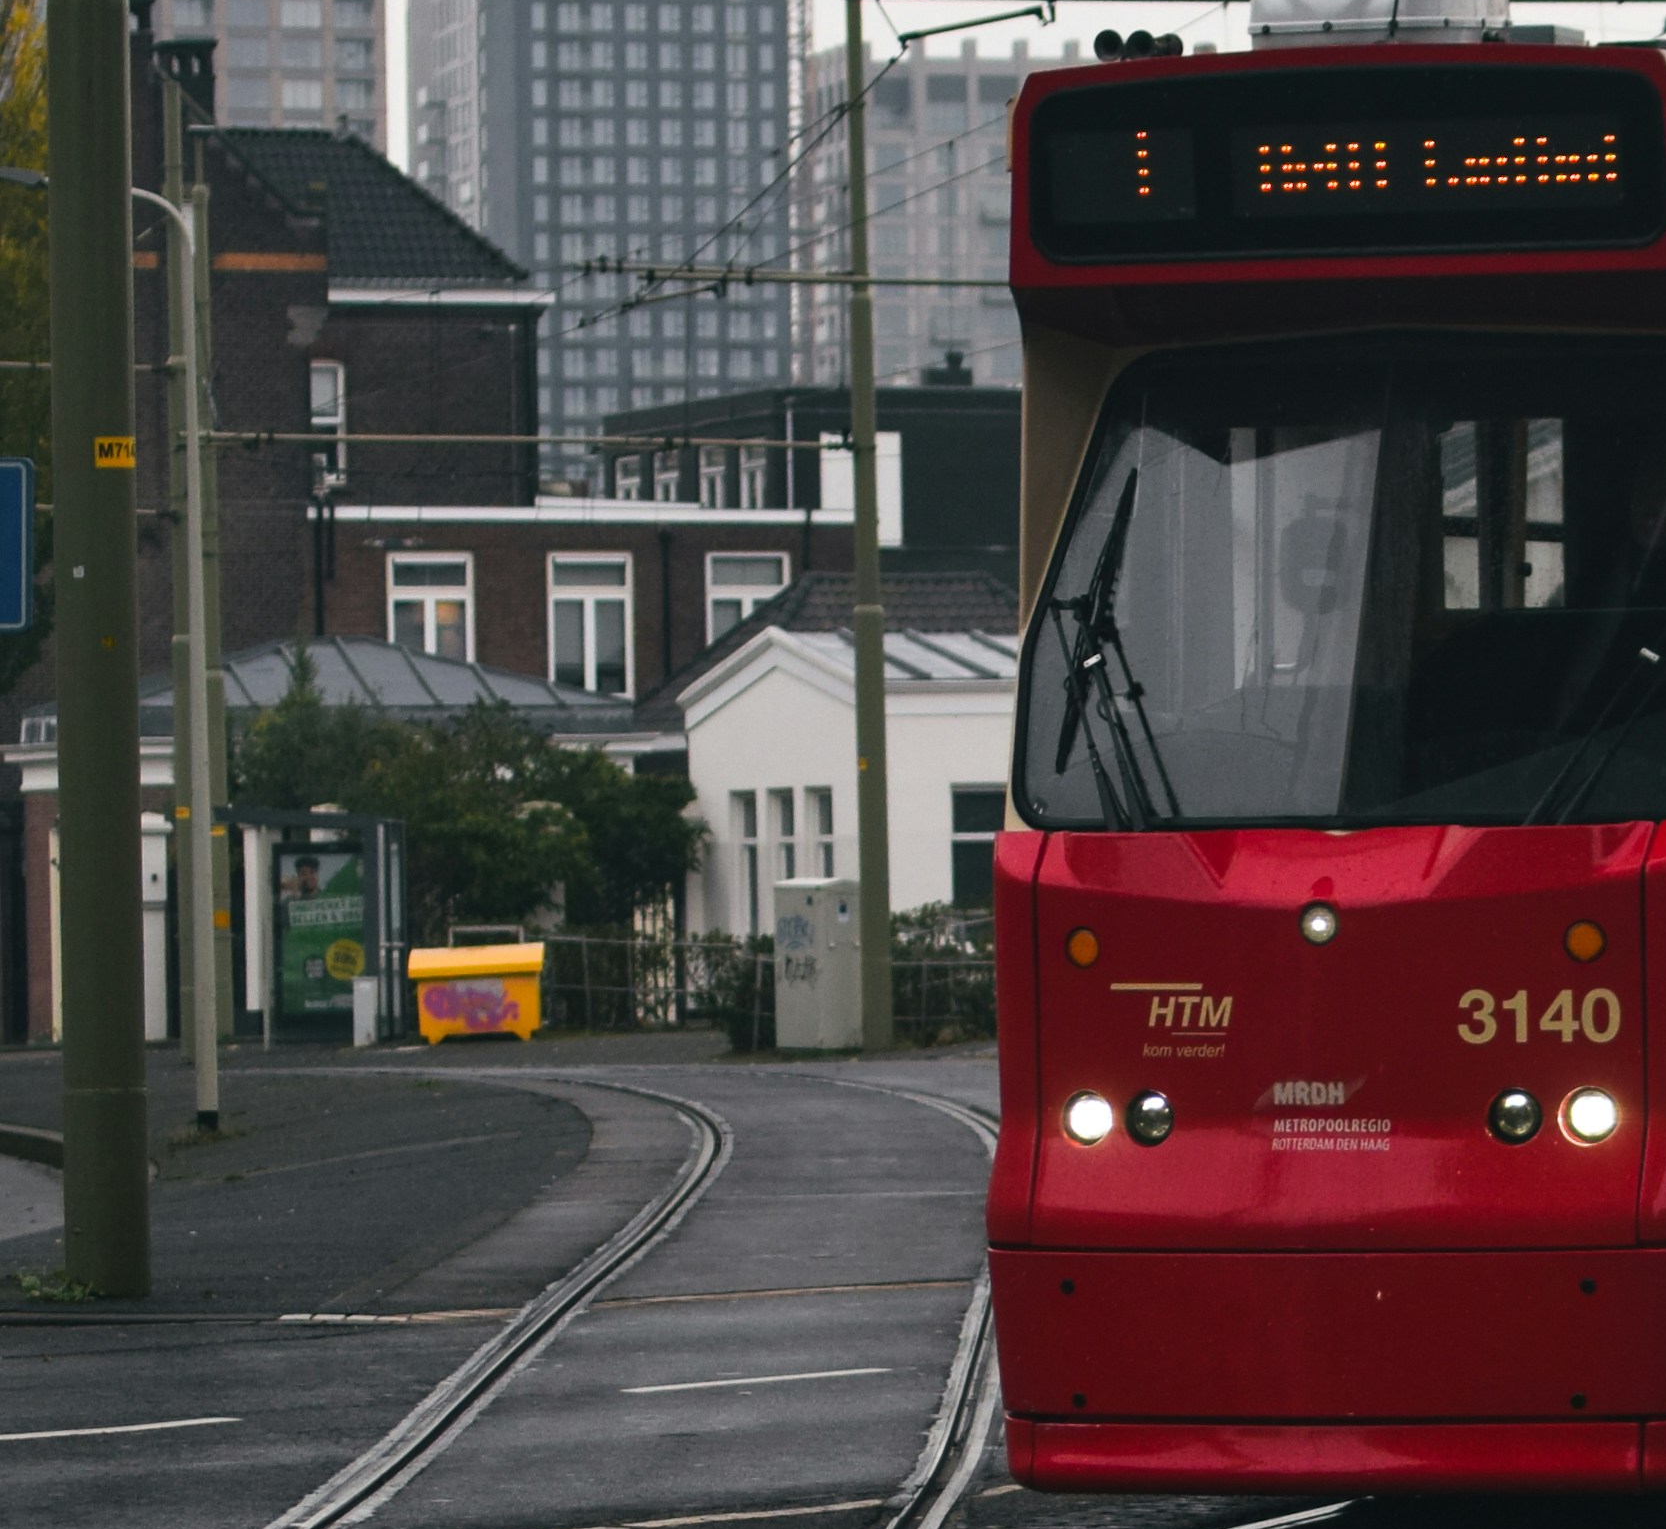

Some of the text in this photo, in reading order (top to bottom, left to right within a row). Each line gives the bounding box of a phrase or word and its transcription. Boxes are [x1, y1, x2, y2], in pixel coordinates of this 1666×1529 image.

[1148, 996, 1233, 1027] HTM
[1457, 987, 1621, 1044] 3140
[1142, 1042, 1226, 1057] kom verder!
[1272, 1080, 1345, 1106] MRDH
[1273, 1118, 1392, 1133] METROPOOLREGIO
[1271, 1138, 1390, 1151] ROTTERDAM DEN HAAG
